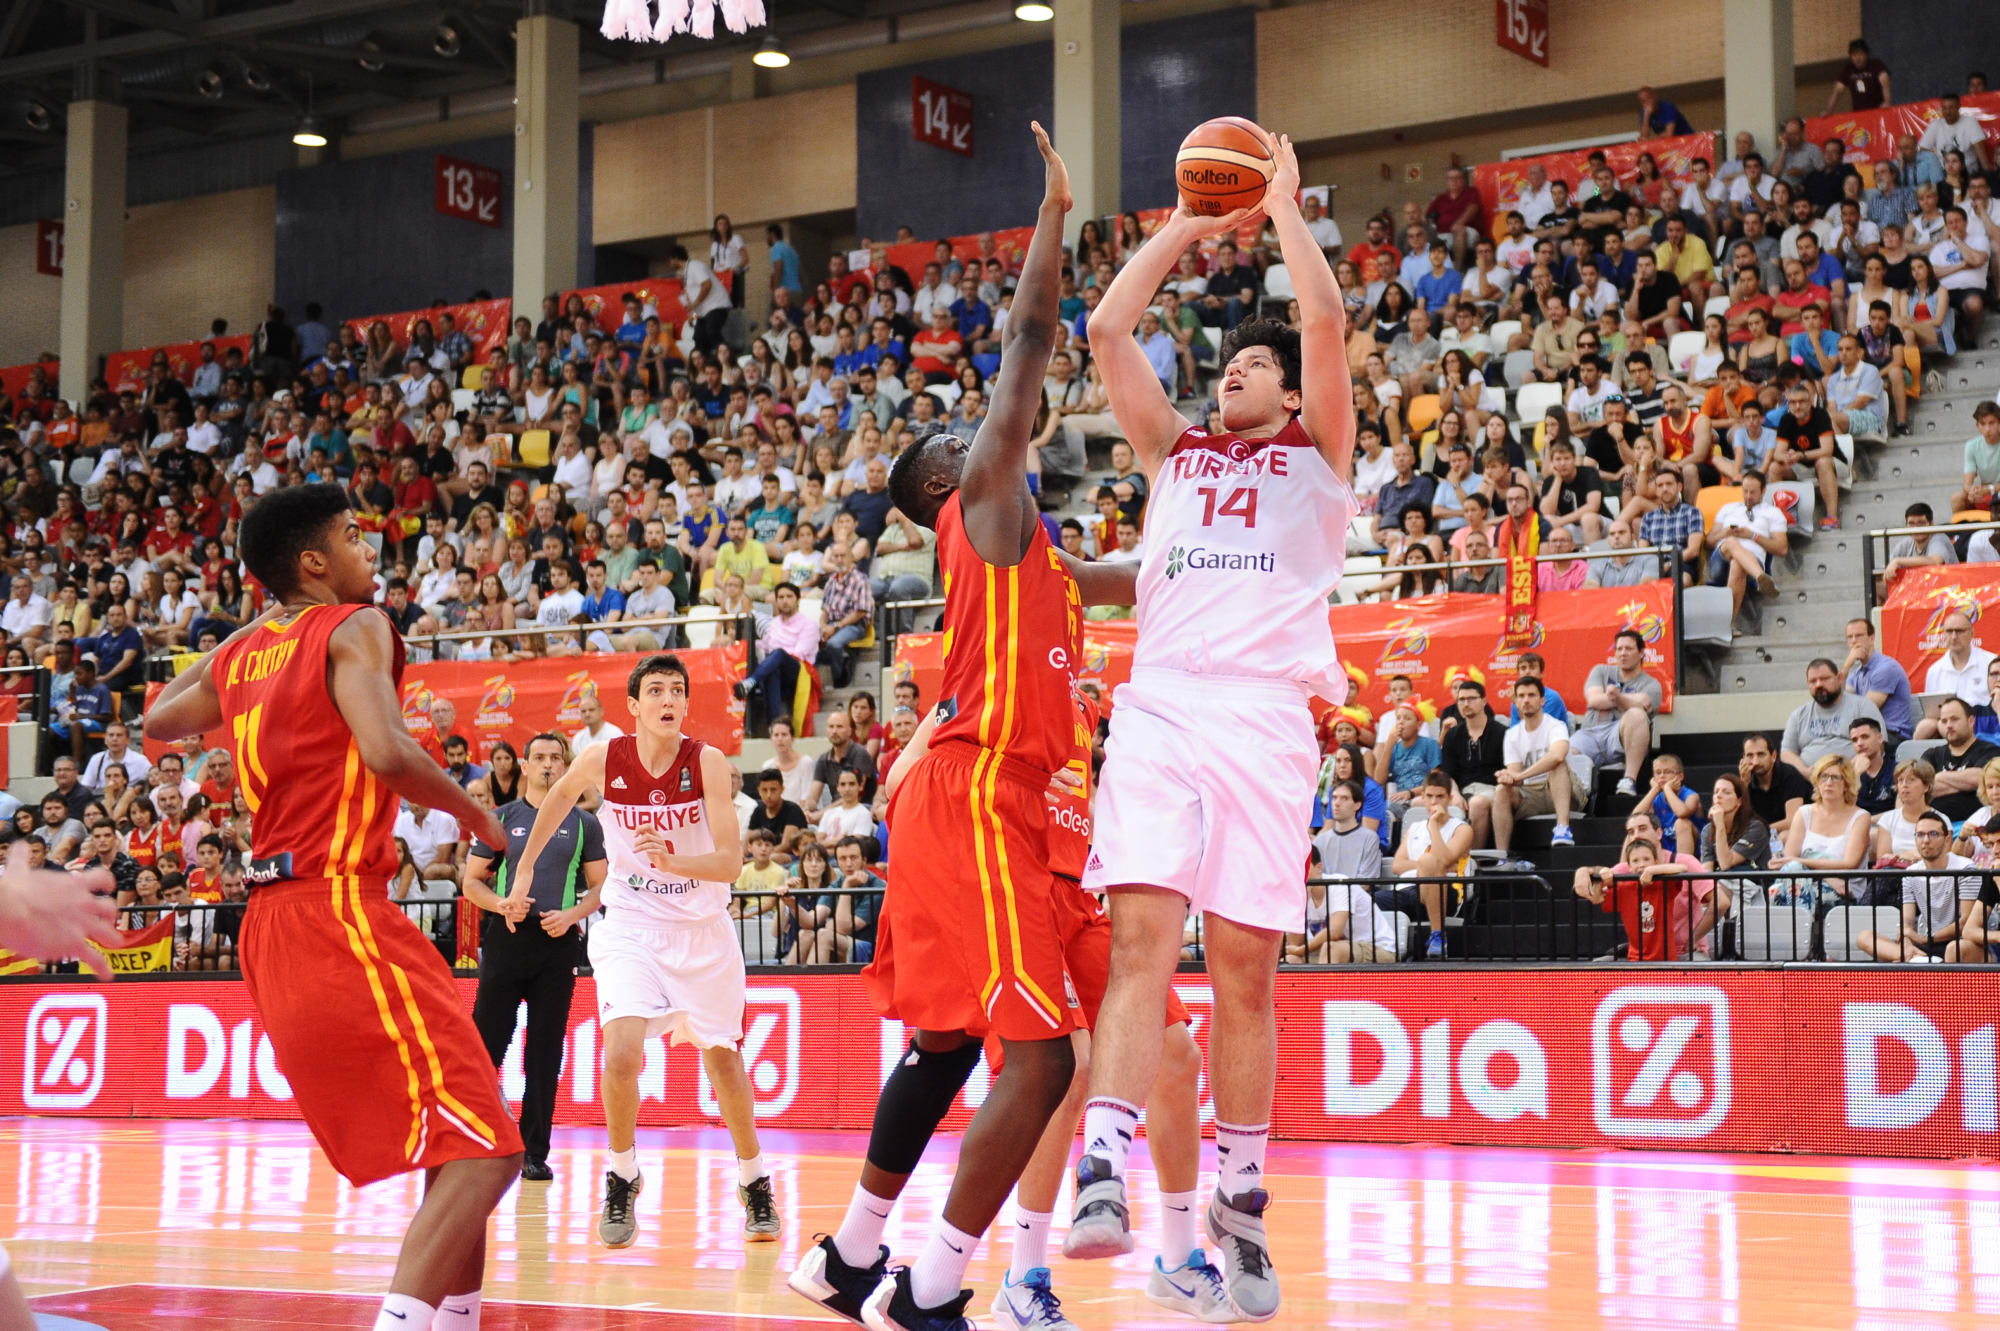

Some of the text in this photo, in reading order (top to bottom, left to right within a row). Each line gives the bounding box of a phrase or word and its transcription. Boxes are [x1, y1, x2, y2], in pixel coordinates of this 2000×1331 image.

[1503, 0, 1529, 45] 15
[919, 89, 950, 140] 14
[442, 164, 475, 212] 13
[1182, 168, 1239, 186] molten
[1197, 486, 1259, 529] 14
[1186, 547, 1275, 573] Garanti
